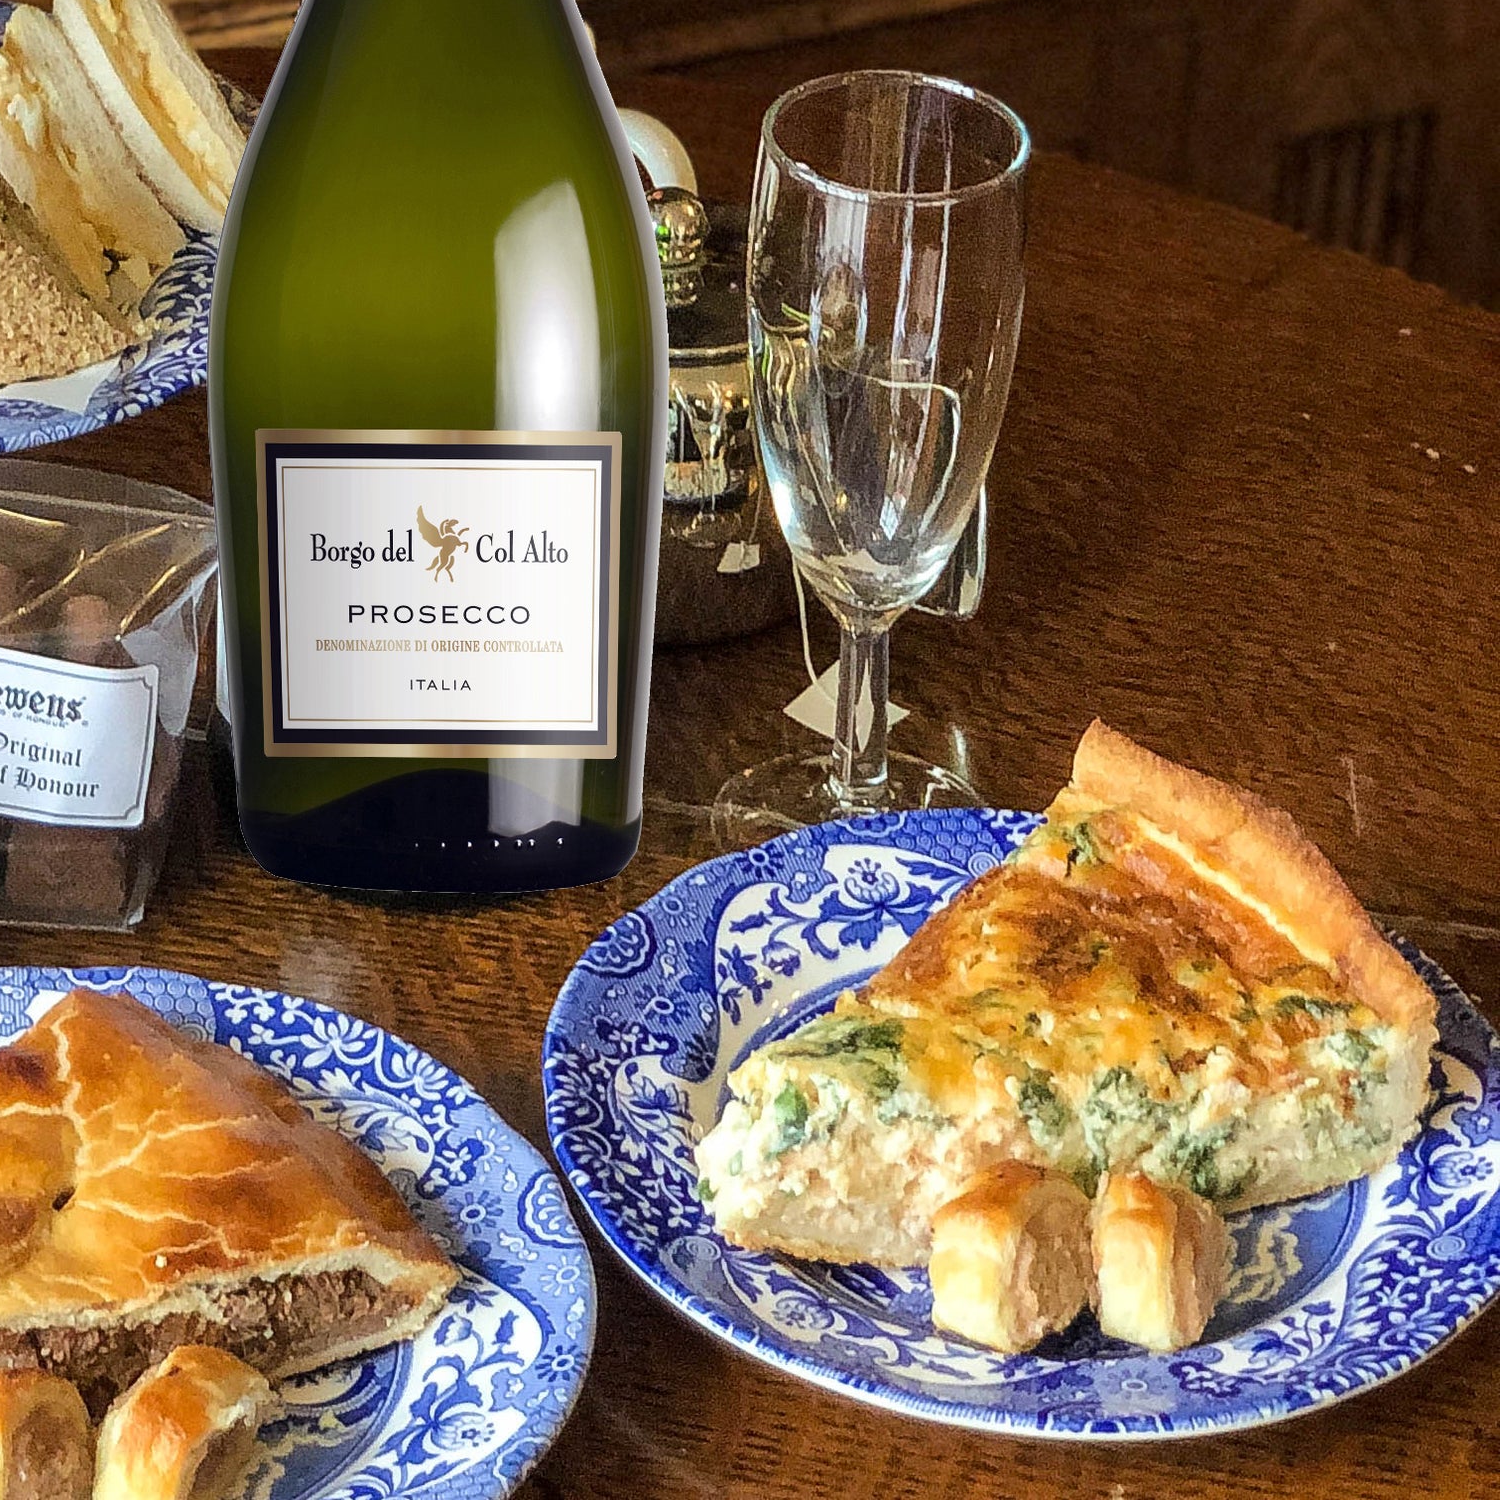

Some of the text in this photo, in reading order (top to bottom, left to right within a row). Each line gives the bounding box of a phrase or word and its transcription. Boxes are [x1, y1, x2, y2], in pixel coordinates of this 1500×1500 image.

[310, 529, 569, 569] Borgo del Col Alto
[348, 604, 530, 624] PROSECCO
[315, 639, 564, 653] DENOMINAZIONE DI ORIGINE CONTROLLATA
[409, 679, 472, 691] ITALIA
[14, 766, 100, 798] Honour
